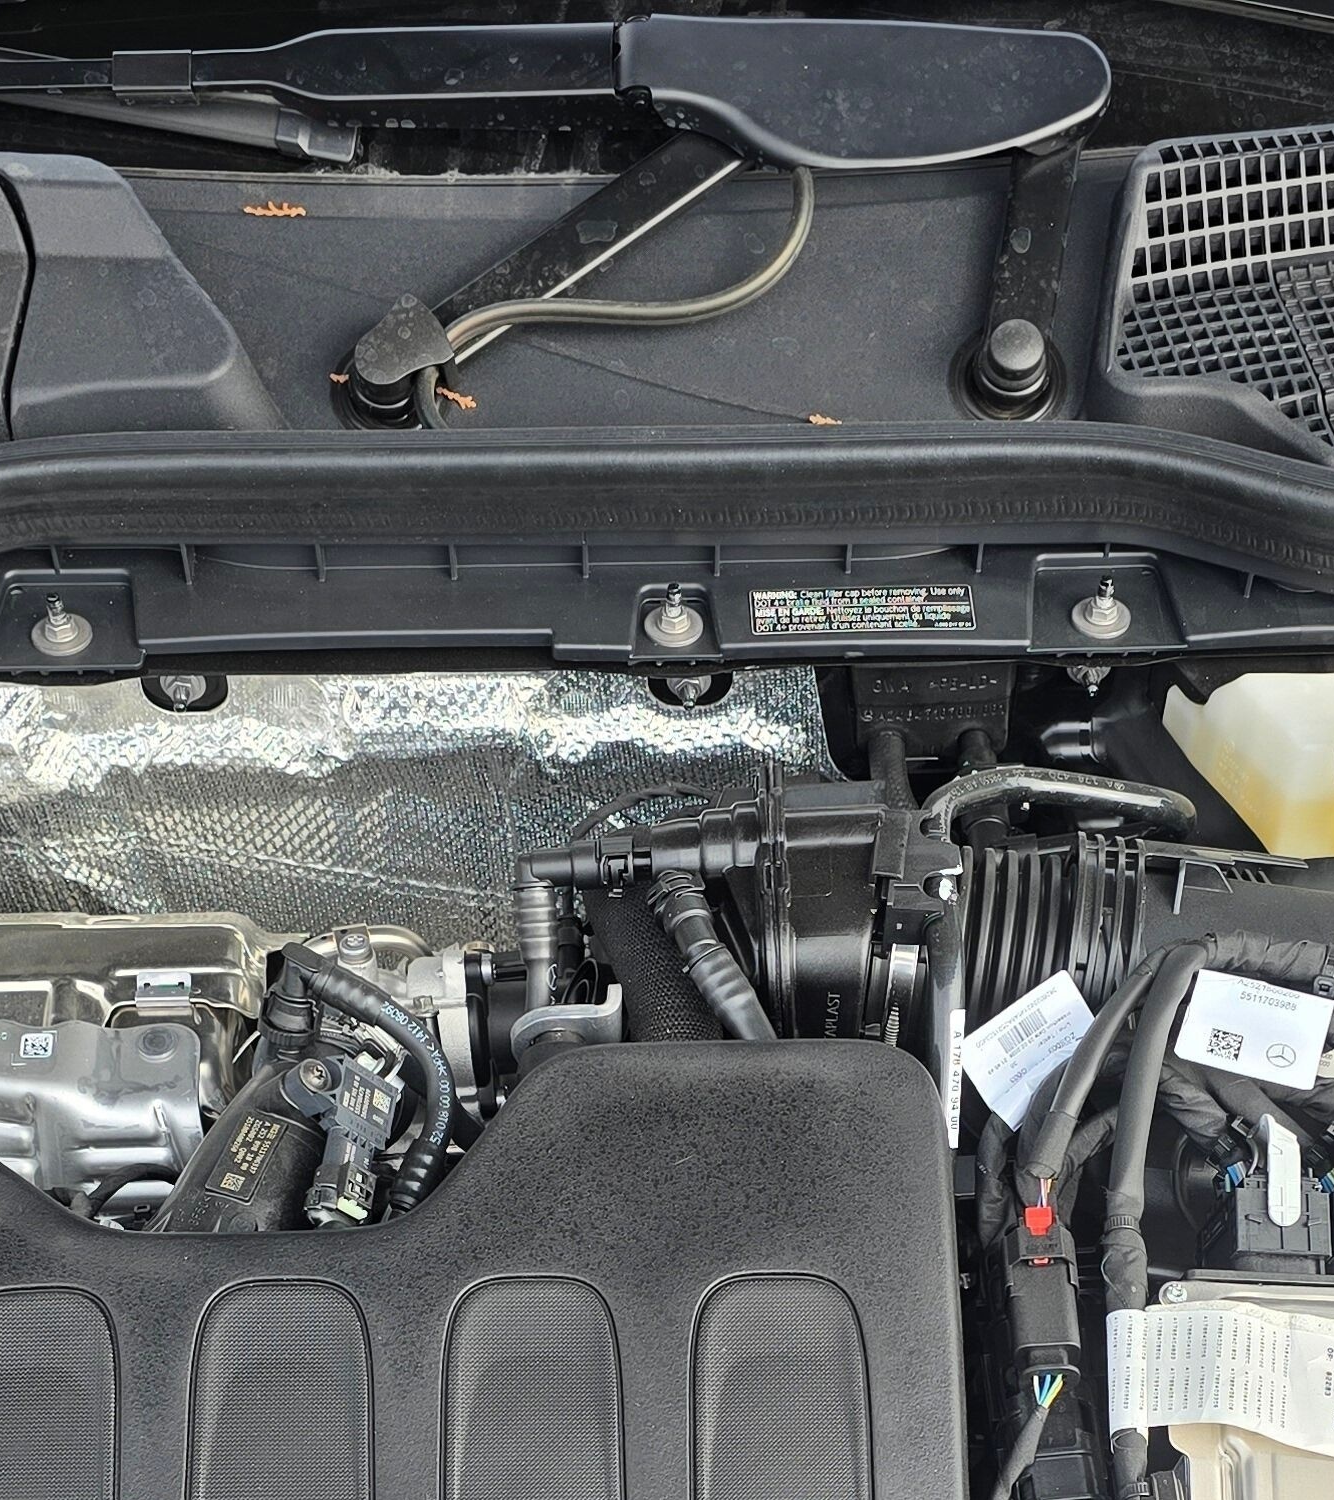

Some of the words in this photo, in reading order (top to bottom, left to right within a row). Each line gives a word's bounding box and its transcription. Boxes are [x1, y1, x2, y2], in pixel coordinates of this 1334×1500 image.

[862, 588, 887, 597] before
[930, 587, 946, 596] Use
[948, 587, 965, 597] only
[954, 1031, 962, 1039] A
[436, 1111, 448, 1130] 018
[430, 1131, 443, 1144] 52
